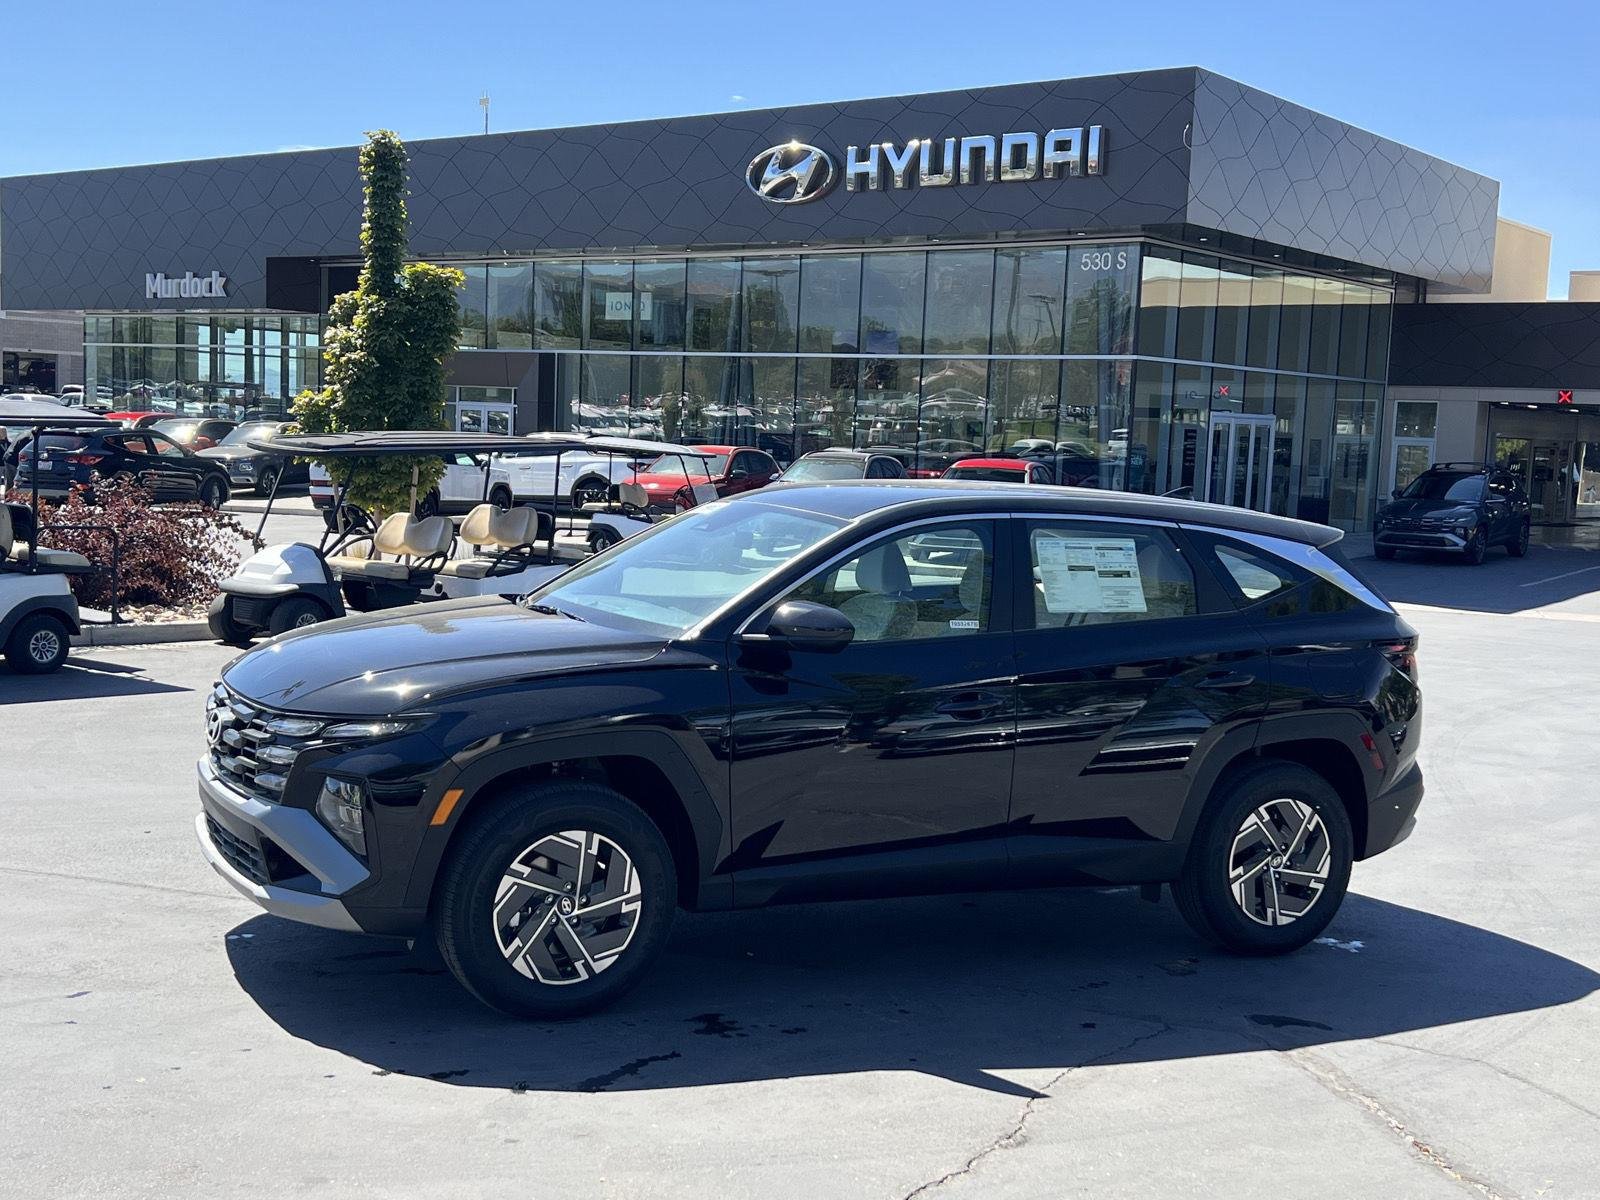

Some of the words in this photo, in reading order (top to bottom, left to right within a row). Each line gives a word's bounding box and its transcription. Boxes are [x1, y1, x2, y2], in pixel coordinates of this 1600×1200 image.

[846, 125, 1104, 192] HYUNDAI
[1081, 252, 1111, 271] 530
[1117, 251, 1127, 270] S
[145, 270, 227, 299] Murdock
